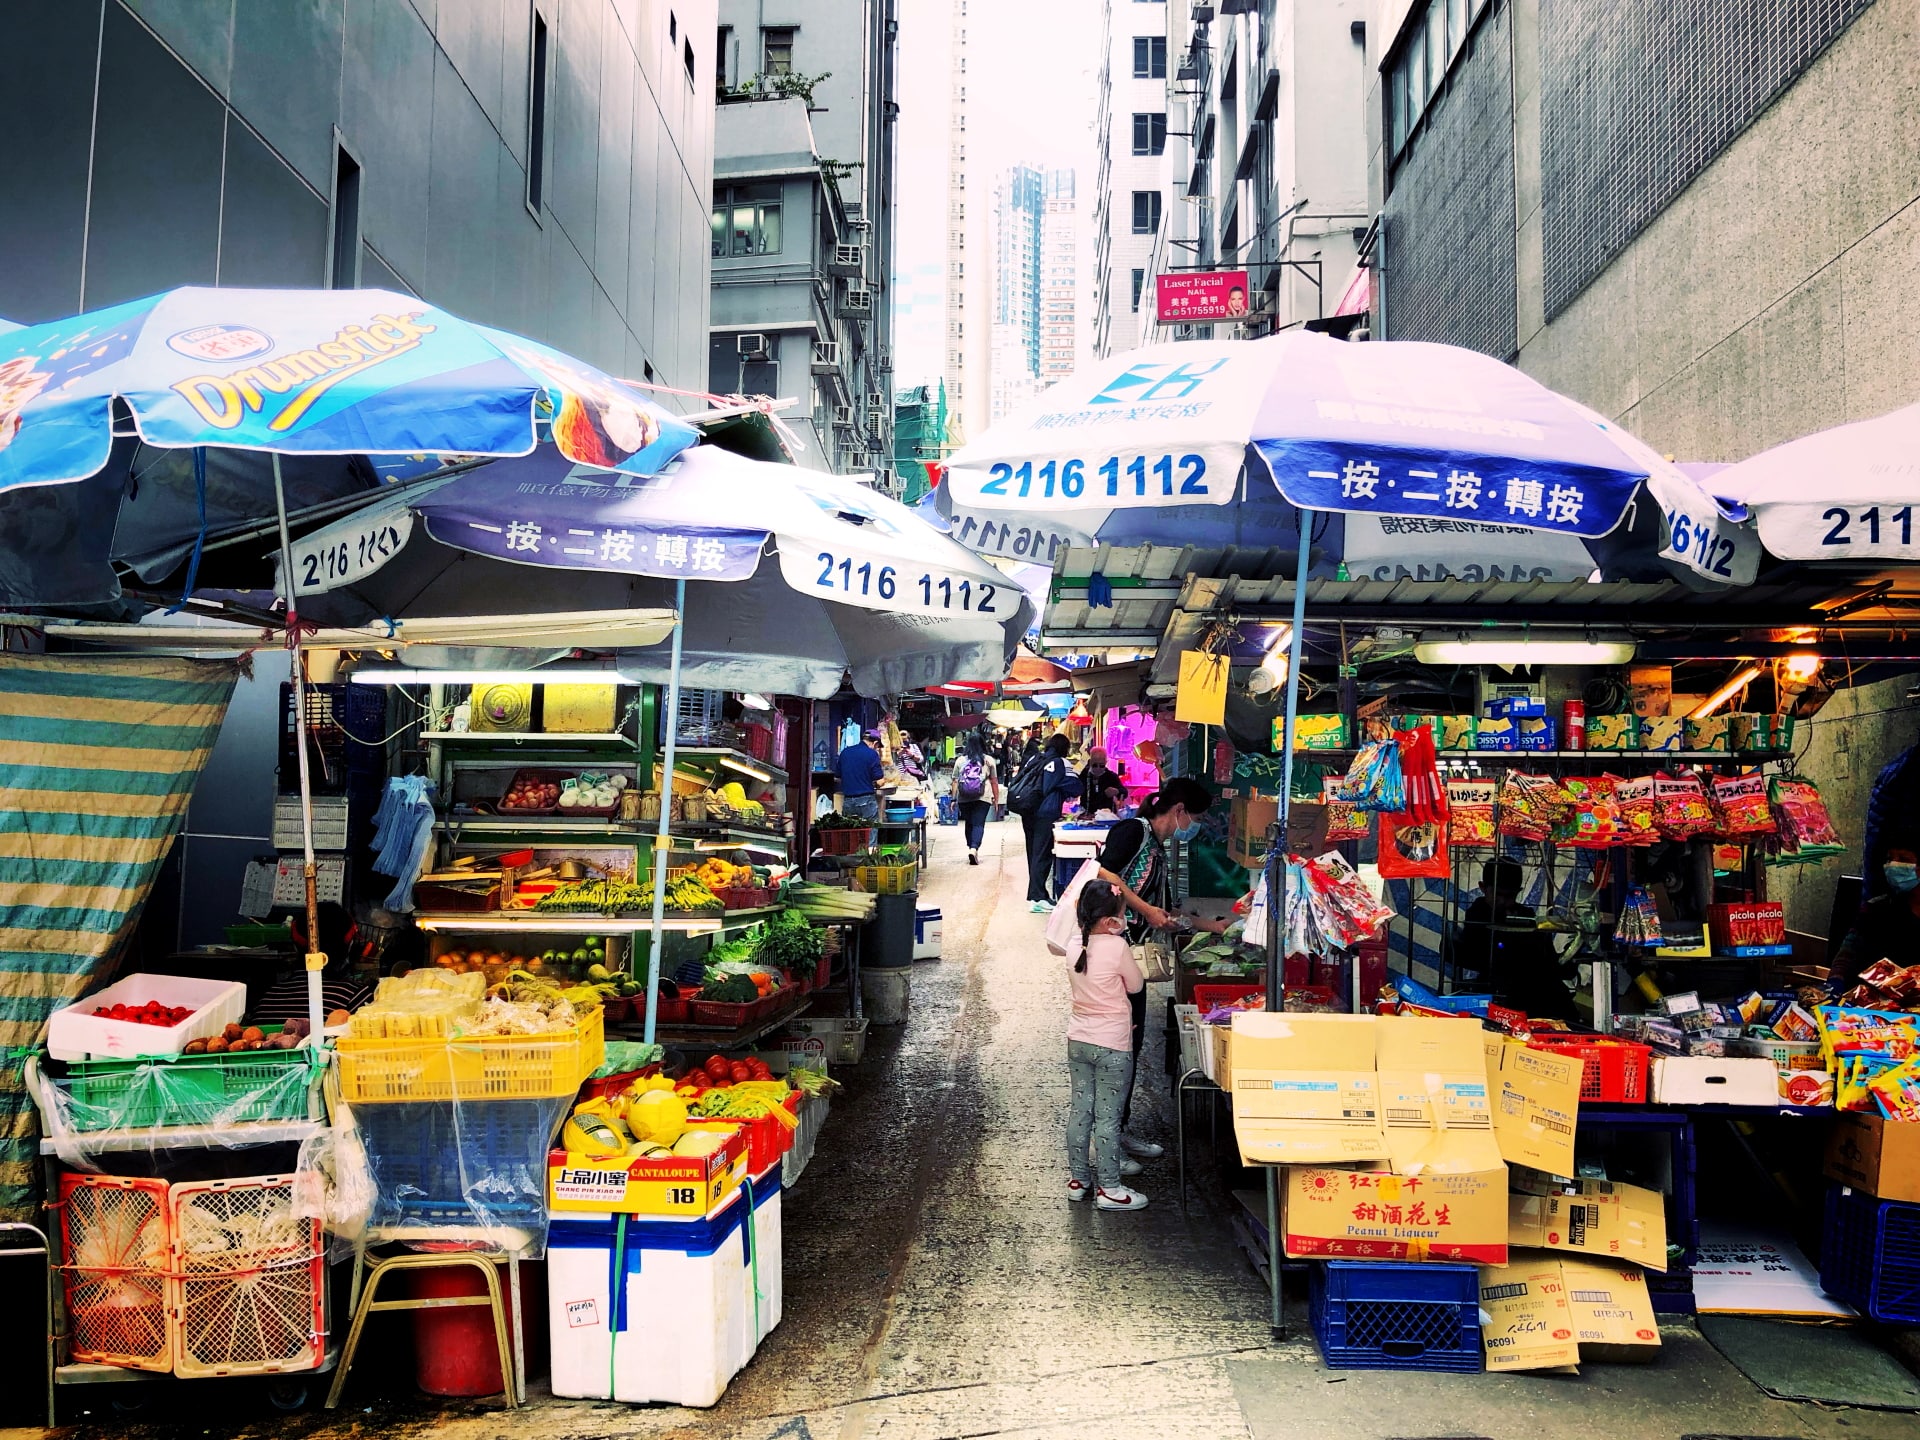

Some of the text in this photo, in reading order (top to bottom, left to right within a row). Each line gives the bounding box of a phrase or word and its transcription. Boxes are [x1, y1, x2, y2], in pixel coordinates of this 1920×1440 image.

[1164, 277, 1223, 288] Laser Facial
[1181, 305, 1225, 315] 51755919
[169, 312, 437, 430] Drumstick
[980, 454, 1208, 498] 2116 1112
[817, 552, 996, 613] 2116 1112
[556, 1169, 627, 1186] 上品小蜜
[631, 1168, 699, 1178] CANTALOUPE
[671, 1188, 695, 1204] 18
[1352, 1201, 1452, 1226] 甜酒花生
[1347, 1225, 1440, 1240] Peanut Liqueur
[1593, 1310, 1634, 1321] Levain
[1487, 1337, 1515, 1348] 16038
